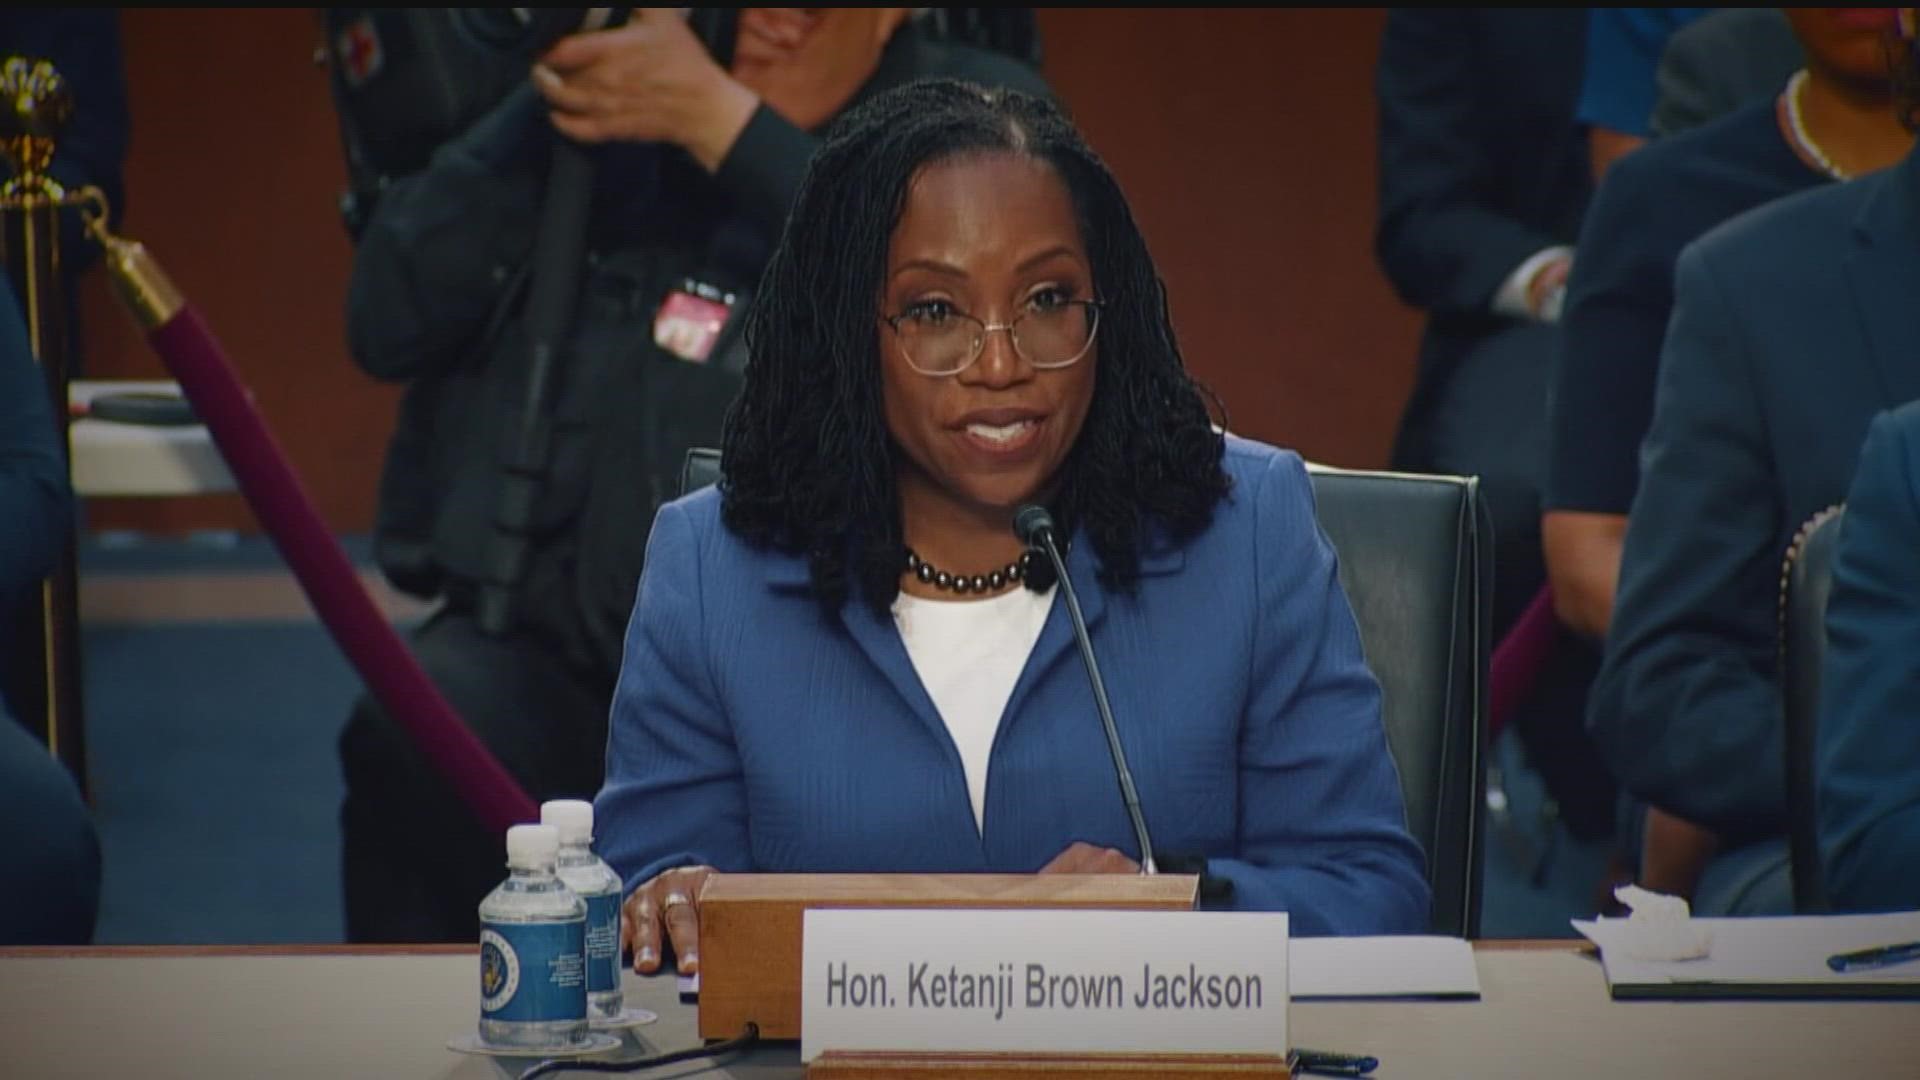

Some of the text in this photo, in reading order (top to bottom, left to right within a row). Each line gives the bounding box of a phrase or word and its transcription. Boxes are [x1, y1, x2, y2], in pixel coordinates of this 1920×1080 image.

[826, 962, 1262, 1021] Hon. Ketanji Brown Jackson
